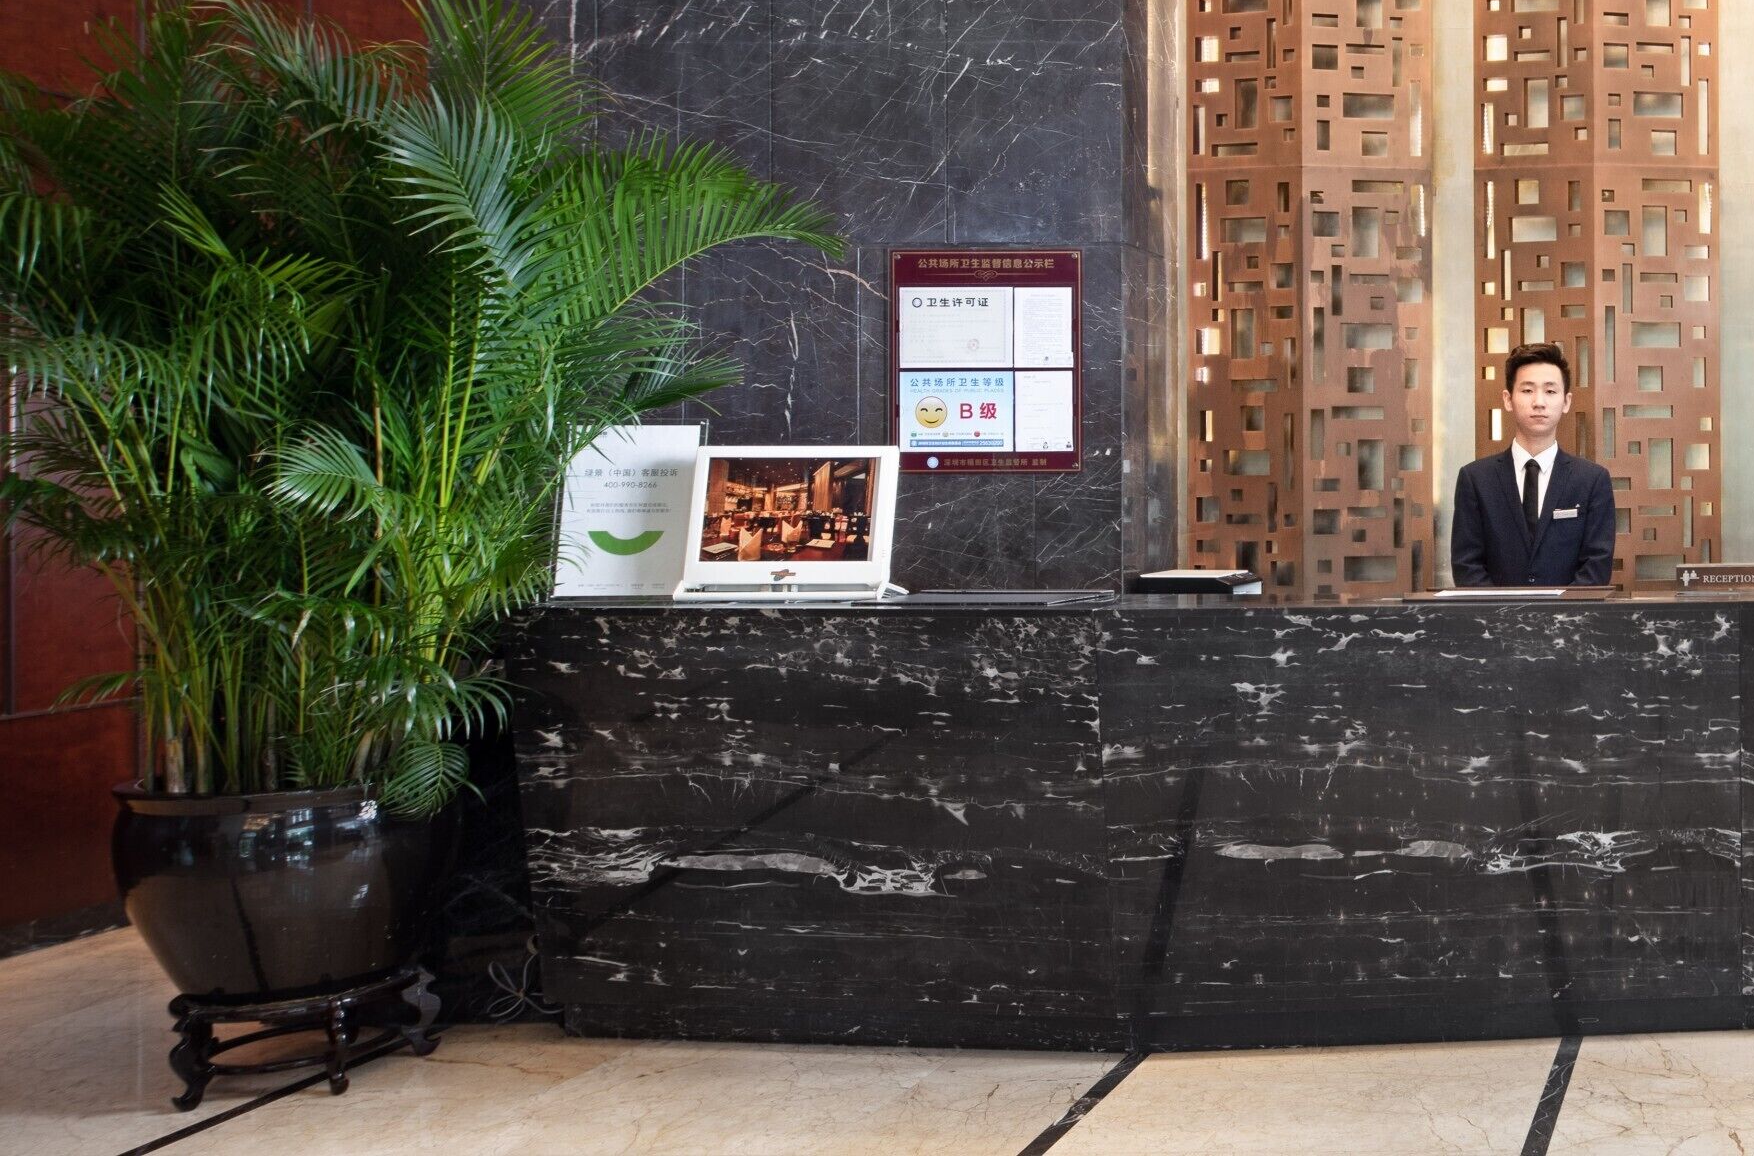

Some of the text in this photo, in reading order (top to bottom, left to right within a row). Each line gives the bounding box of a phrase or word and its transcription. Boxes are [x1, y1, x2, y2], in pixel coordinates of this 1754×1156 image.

[918, 258, 1055, 269] 公共场所卫生监督信息公示栏
[926, 297, 989, 307] 卫生许可证
[910, 377, 1004, 387] 公共场所卫生等级
